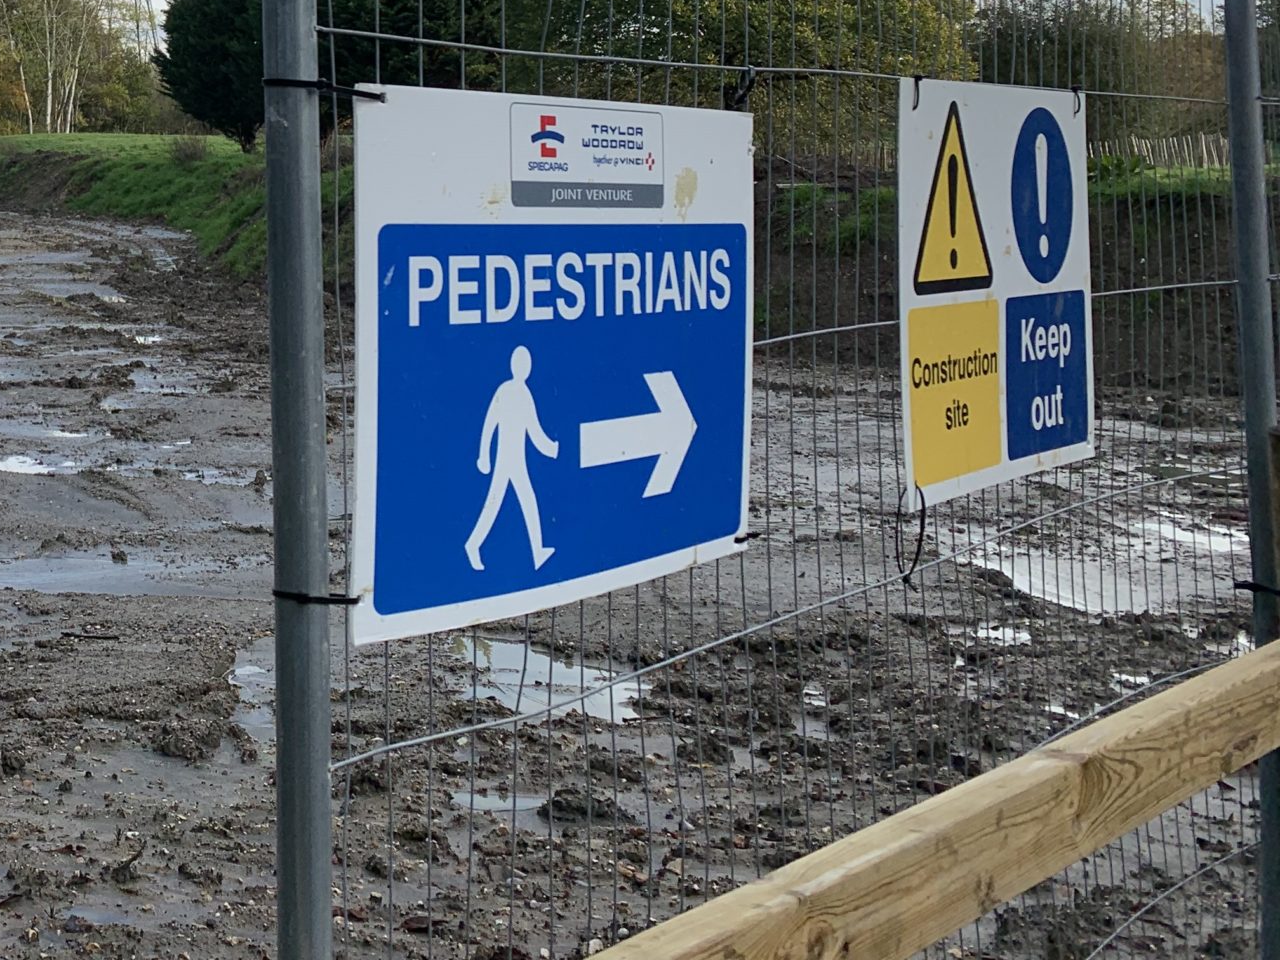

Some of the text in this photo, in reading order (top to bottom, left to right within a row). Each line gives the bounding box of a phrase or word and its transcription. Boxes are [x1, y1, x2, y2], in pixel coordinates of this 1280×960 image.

[591, 124, 644, 136] TAYLOR
[582, 138, 644, 150] WOODROW
[528, 161, 569, 172] SPIECAPAG
[619, 157, 644, 166] VINCI
[551, 188, 633, 203] JOINT VENTURE
[408, 248, 732, 327] PEDESTRIANS
[1021, 317, 1071, 368] Keep
[911, 348, 998, 389] Construction
[945, 398, 969, 430] site
[1031, 385, 1064, 431] out
